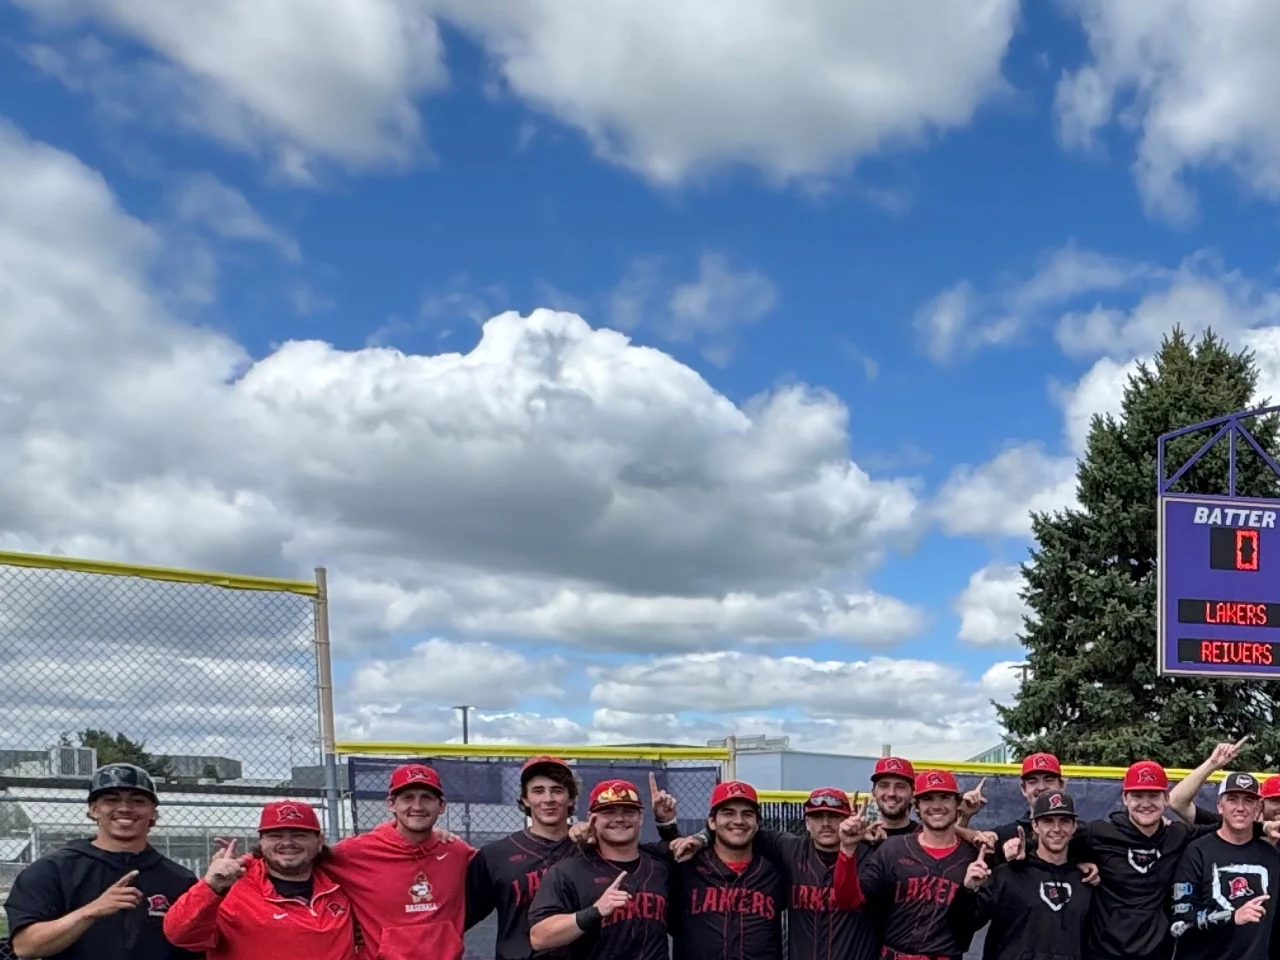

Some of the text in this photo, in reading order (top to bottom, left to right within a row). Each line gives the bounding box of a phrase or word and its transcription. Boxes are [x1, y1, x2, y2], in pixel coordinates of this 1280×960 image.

[1193, 506, 1277, 529] BATTER
[1235, 530, 1259, 570] 0
[1205, 602, 1268, 625] LAKERS
[1201, 641, 1273, 665] REIVERS
[690, 886, 776, 920] LAKERS
